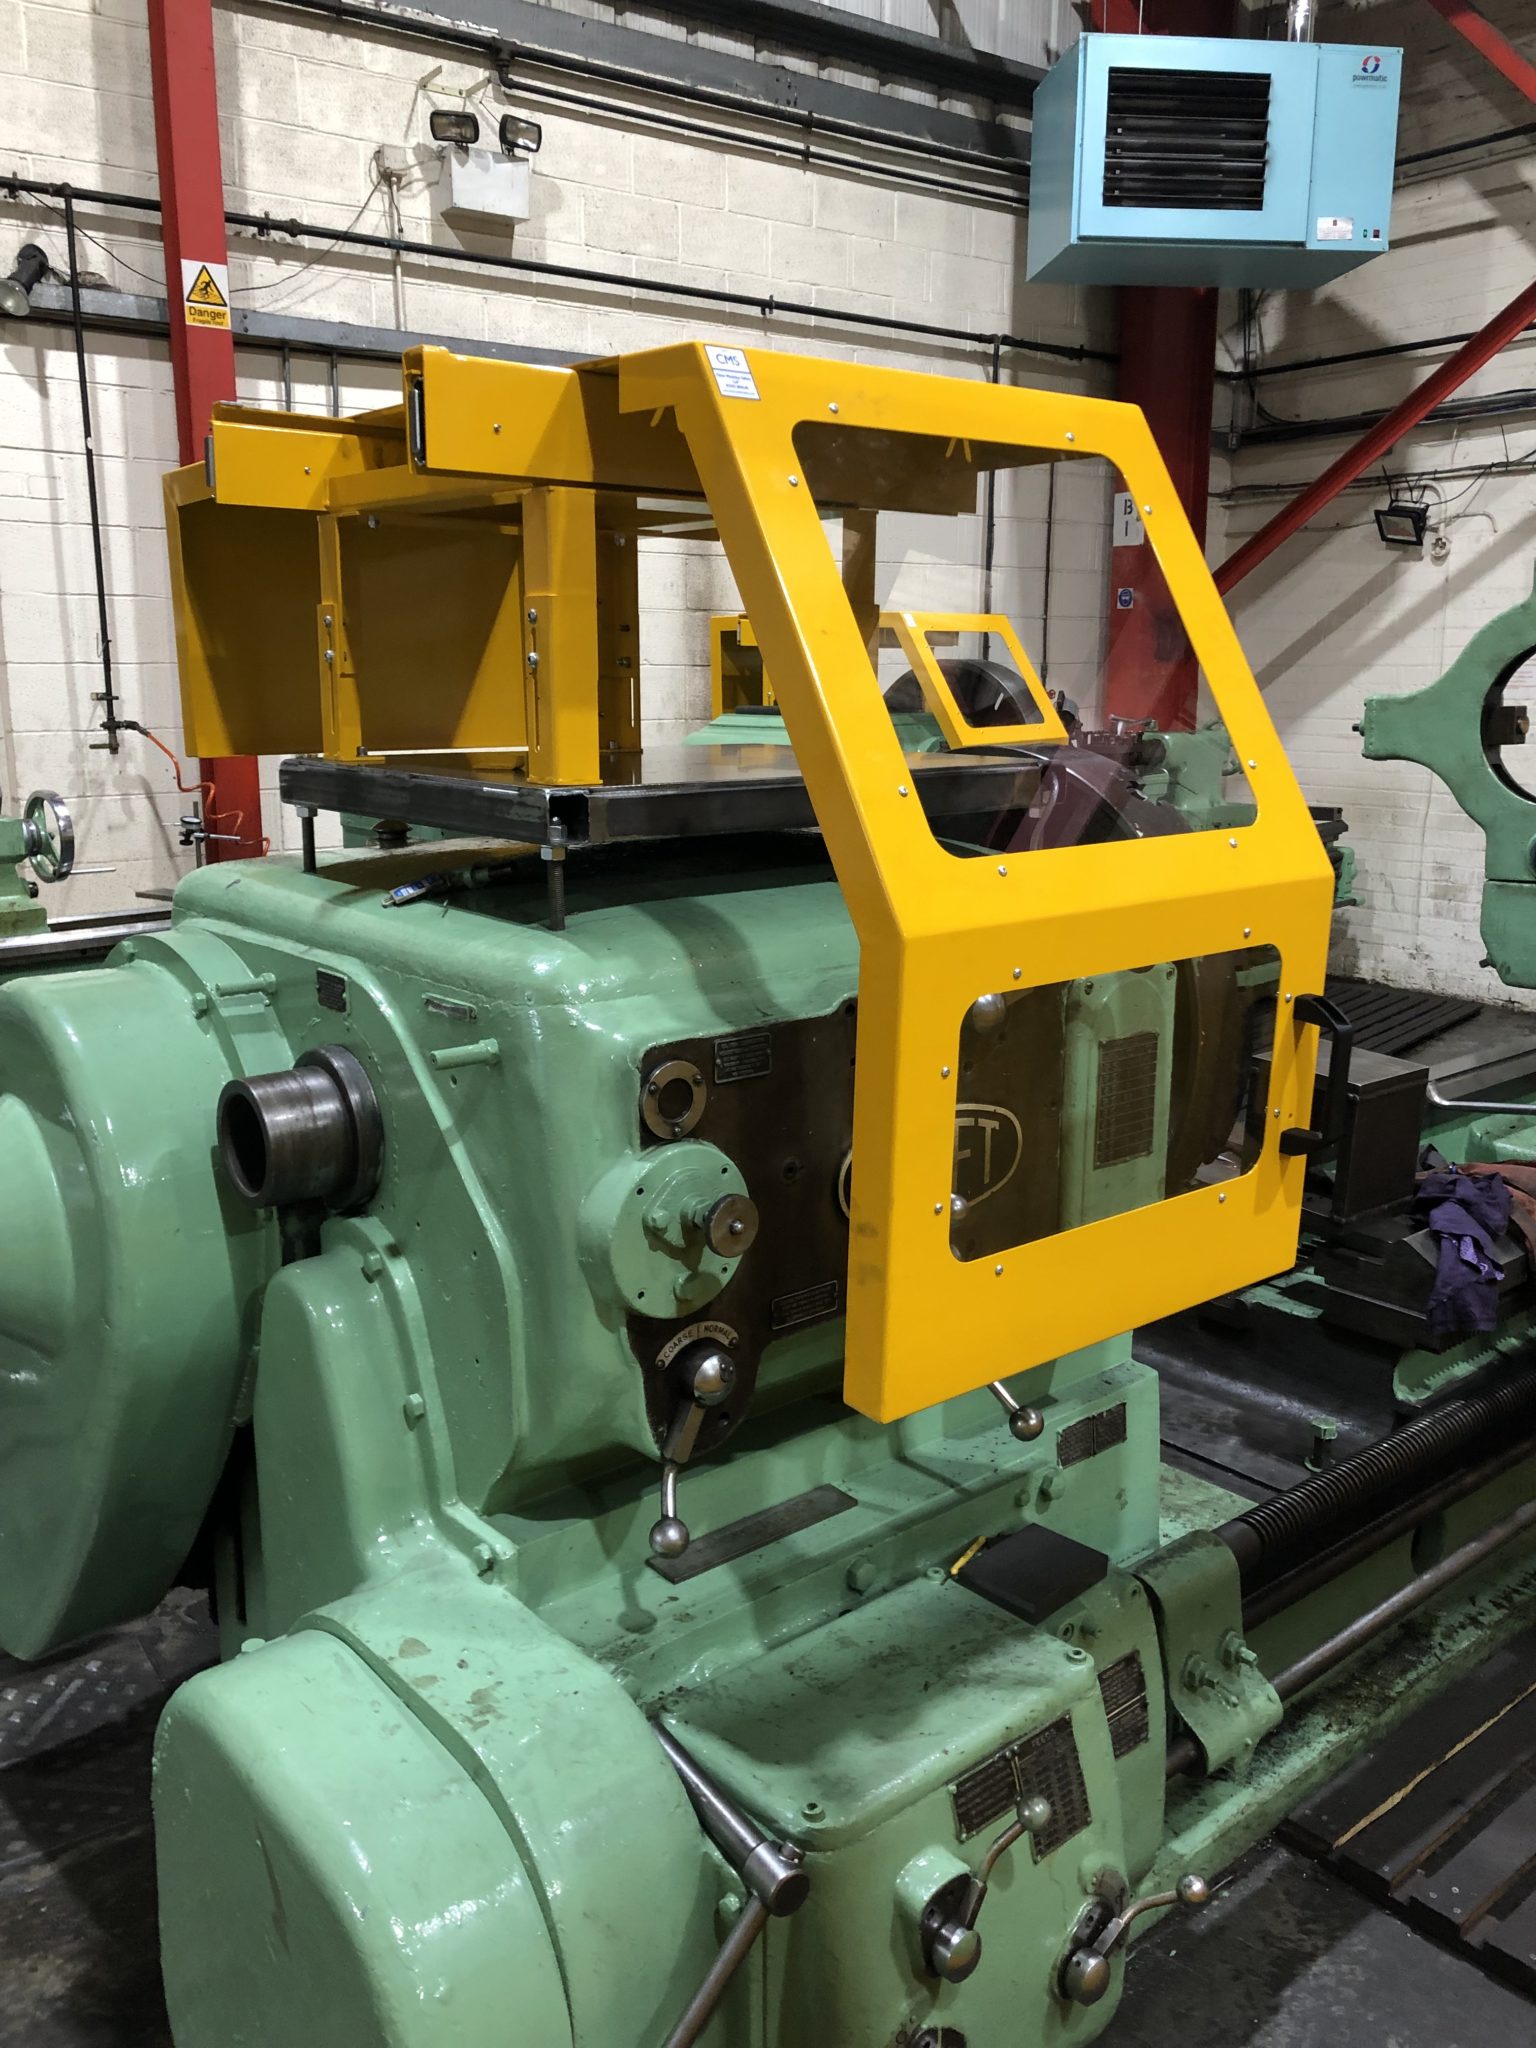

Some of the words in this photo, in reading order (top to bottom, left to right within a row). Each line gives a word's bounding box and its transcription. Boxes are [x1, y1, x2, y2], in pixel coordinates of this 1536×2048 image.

[189, 306, 227, 321] Danger
[715, 353, 741, 367] CMS
[1123, 498, 1133, 516] B
[663, 1329, 695, 1359] COARSE
[703, 1323, 733, 1340] NORMAL
